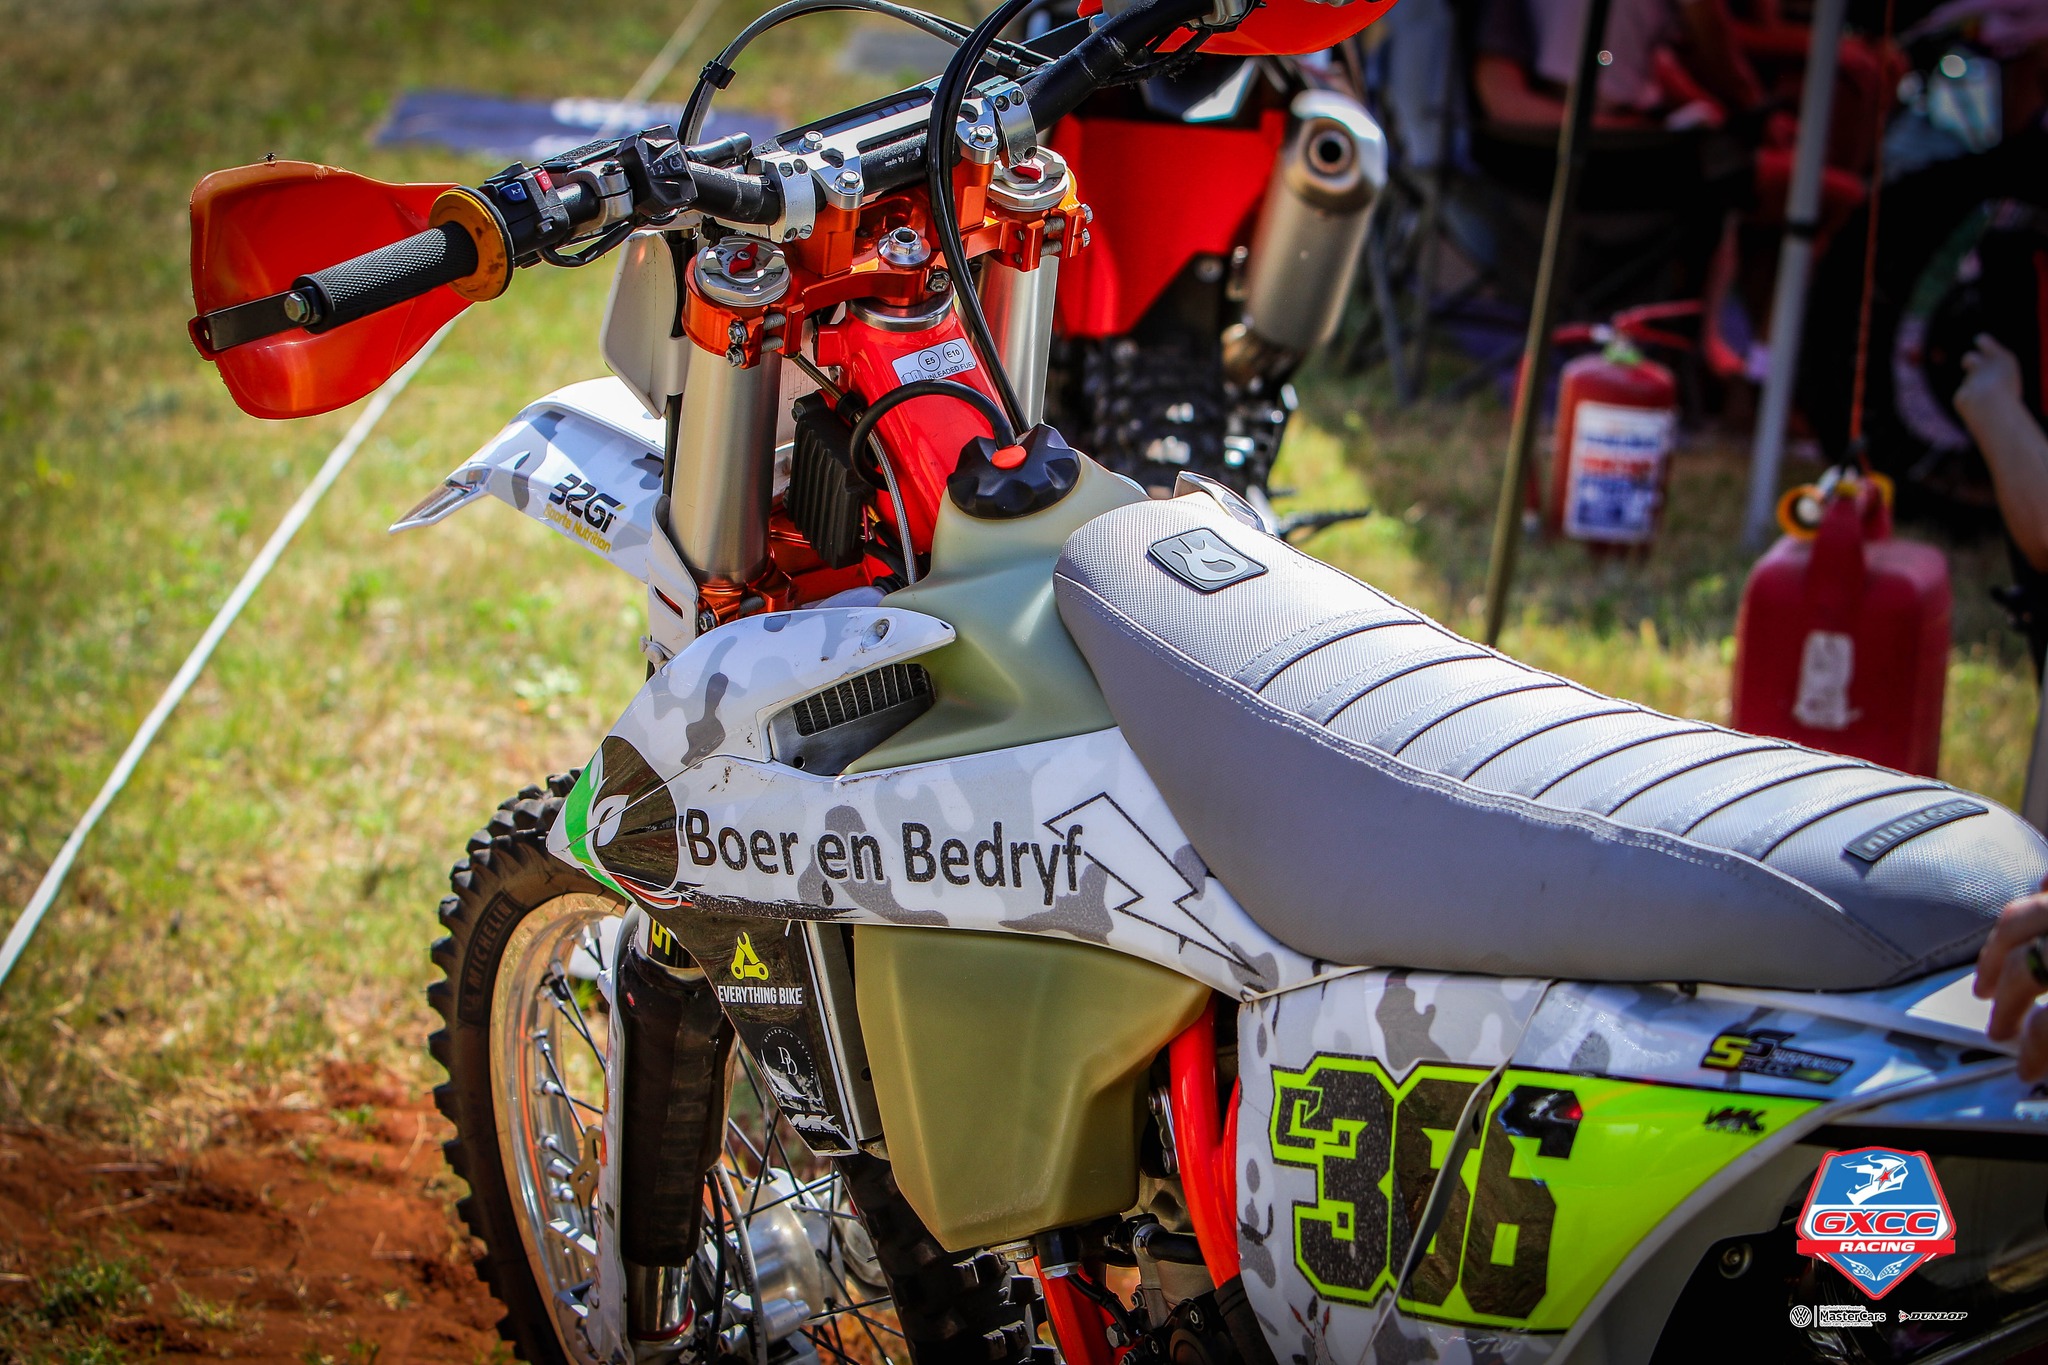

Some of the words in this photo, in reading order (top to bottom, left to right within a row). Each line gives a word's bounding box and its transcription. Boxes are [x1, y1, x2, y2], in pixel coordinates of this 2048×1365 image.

[925, 357, 936, 366] E5
[946, 349, 961, 358] E10
[960, 361, 975, 370] FUEL
[544, 503, 571, 530] Sports
[572, 521, 612, 554] Nutrition
[685, 808, 799, 877] Boer
[816, 832, 885, 882] en
[901, 821, 1084, 906] Bedryf
[468, 901, 514, 987] MICHELIN
[717, 985, 777, 1004] EVERYTHING
[779, 986, 803, 1005] BIKE
